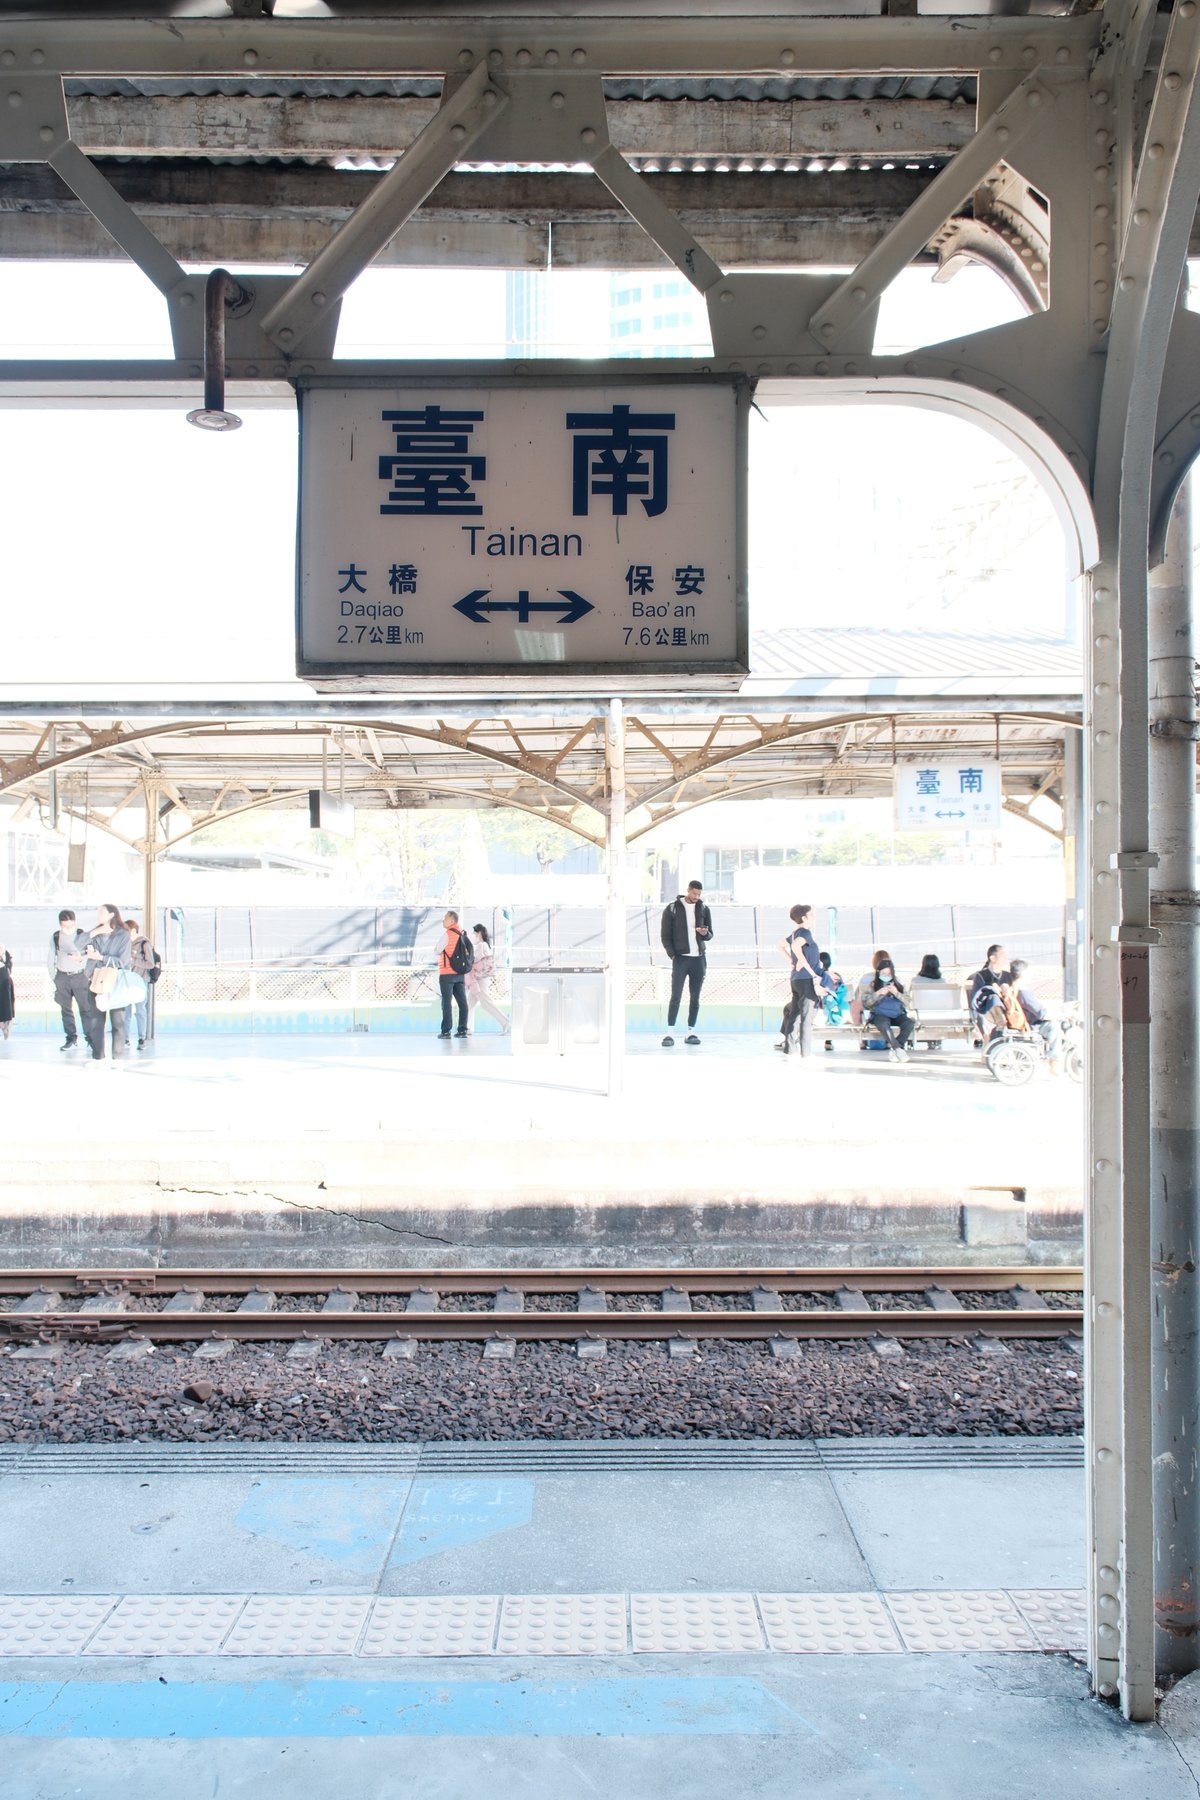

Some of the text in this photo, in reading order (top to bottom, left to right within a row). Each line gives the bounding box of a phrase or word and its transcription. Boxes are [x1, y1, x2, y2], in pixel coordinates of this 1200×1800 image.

[378, 404, 676, 518] 臺南
[461, 525, 583, 557] Tainan
[338, 563, 418, 595] 大橋
[625, 564, 705, 596] 保安
[340, 600, 404, 621] Daqiao
[632, 601, 695, 618] Bao'an
[916, 768, 983, 795] 臺南
